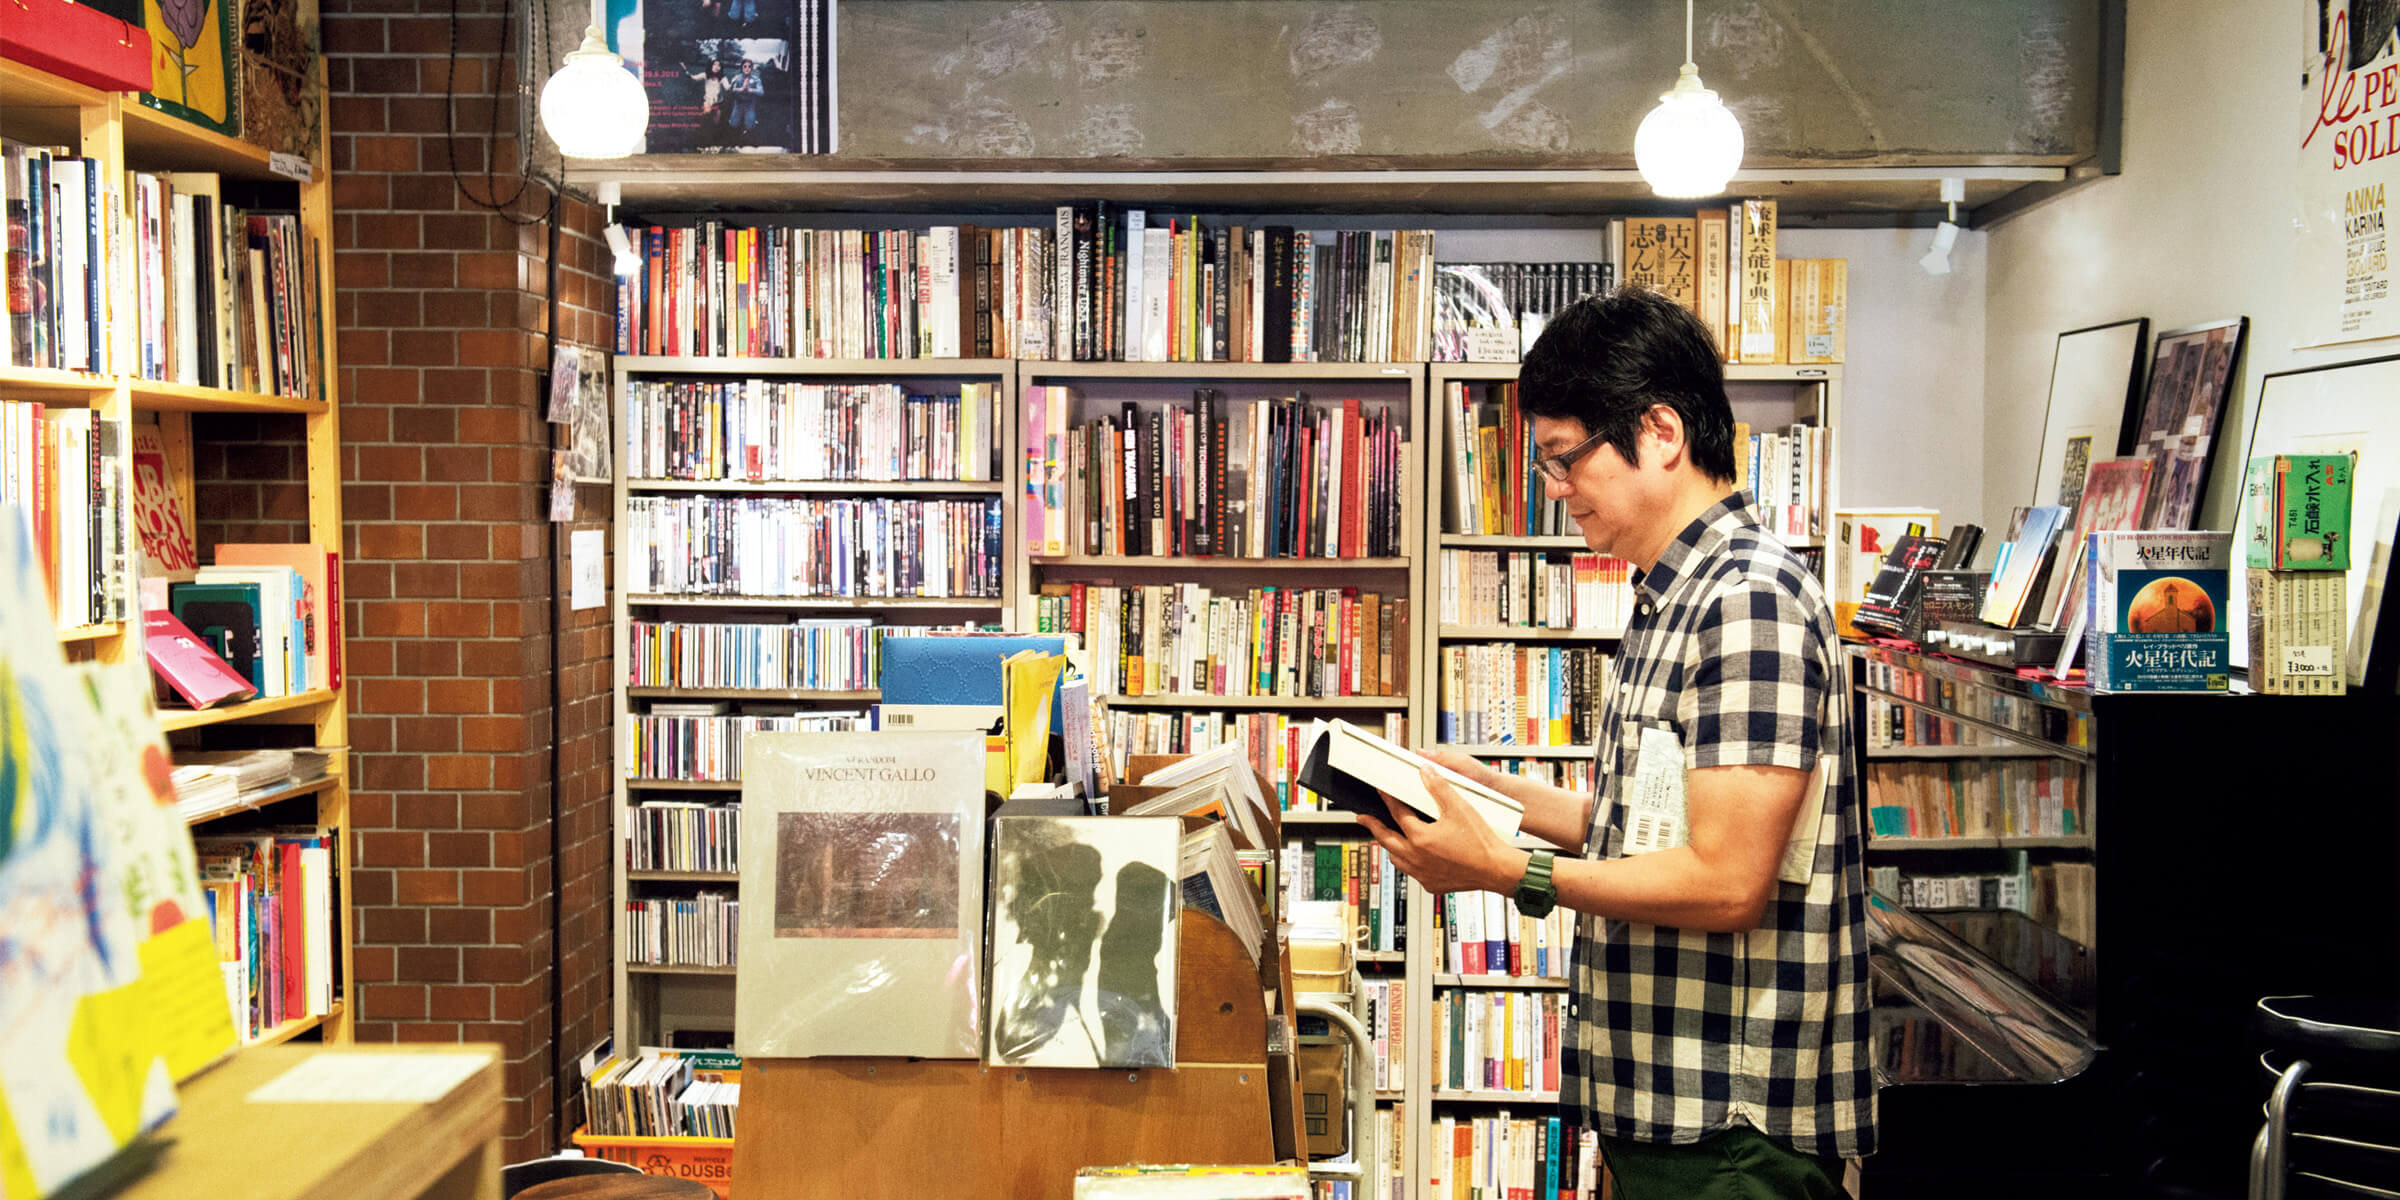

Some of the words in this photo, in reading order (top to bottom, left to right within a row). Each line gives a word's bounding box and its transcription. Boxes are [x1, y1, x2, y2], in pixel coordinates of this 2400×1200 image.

[2302, 10, 2360, 150] le
[2344, 182, 2386, 217] ANNA
[1059, 210, 1071, 267] FRANÇAIS
[2345, 210, 2385, 240] KARINA
[1077, 240, 1091, 295] Nightmare
[1667, 223, 1692, 298] 古今亭
[1748, 206, 1772, 302] 琉球芸能事典
[1151, 417, 1160, 470] TAKAKURA
[1152, 472, 1161, 491] KEN
[1199, 445, 1208, 504] TECHNICOLOR
[1153, 496, 1162, 517] SOU
[2304, 459, 2321, 534] 石鹸水入れ
[157, 538, 200, 571] CINE
[1327, 543, 1336, 556] 3
[2136, 546, 2210, 561] 火星年代記
[2125, 650, 2217, 668] 火星年代記
[805, 767, 877, 782] VINCENT
[879, 767, 936, 782] GALLO
[1391, 983, 1403, 1011] DENNIS
[1391, 1013, 1403, 1045] HOPPER
